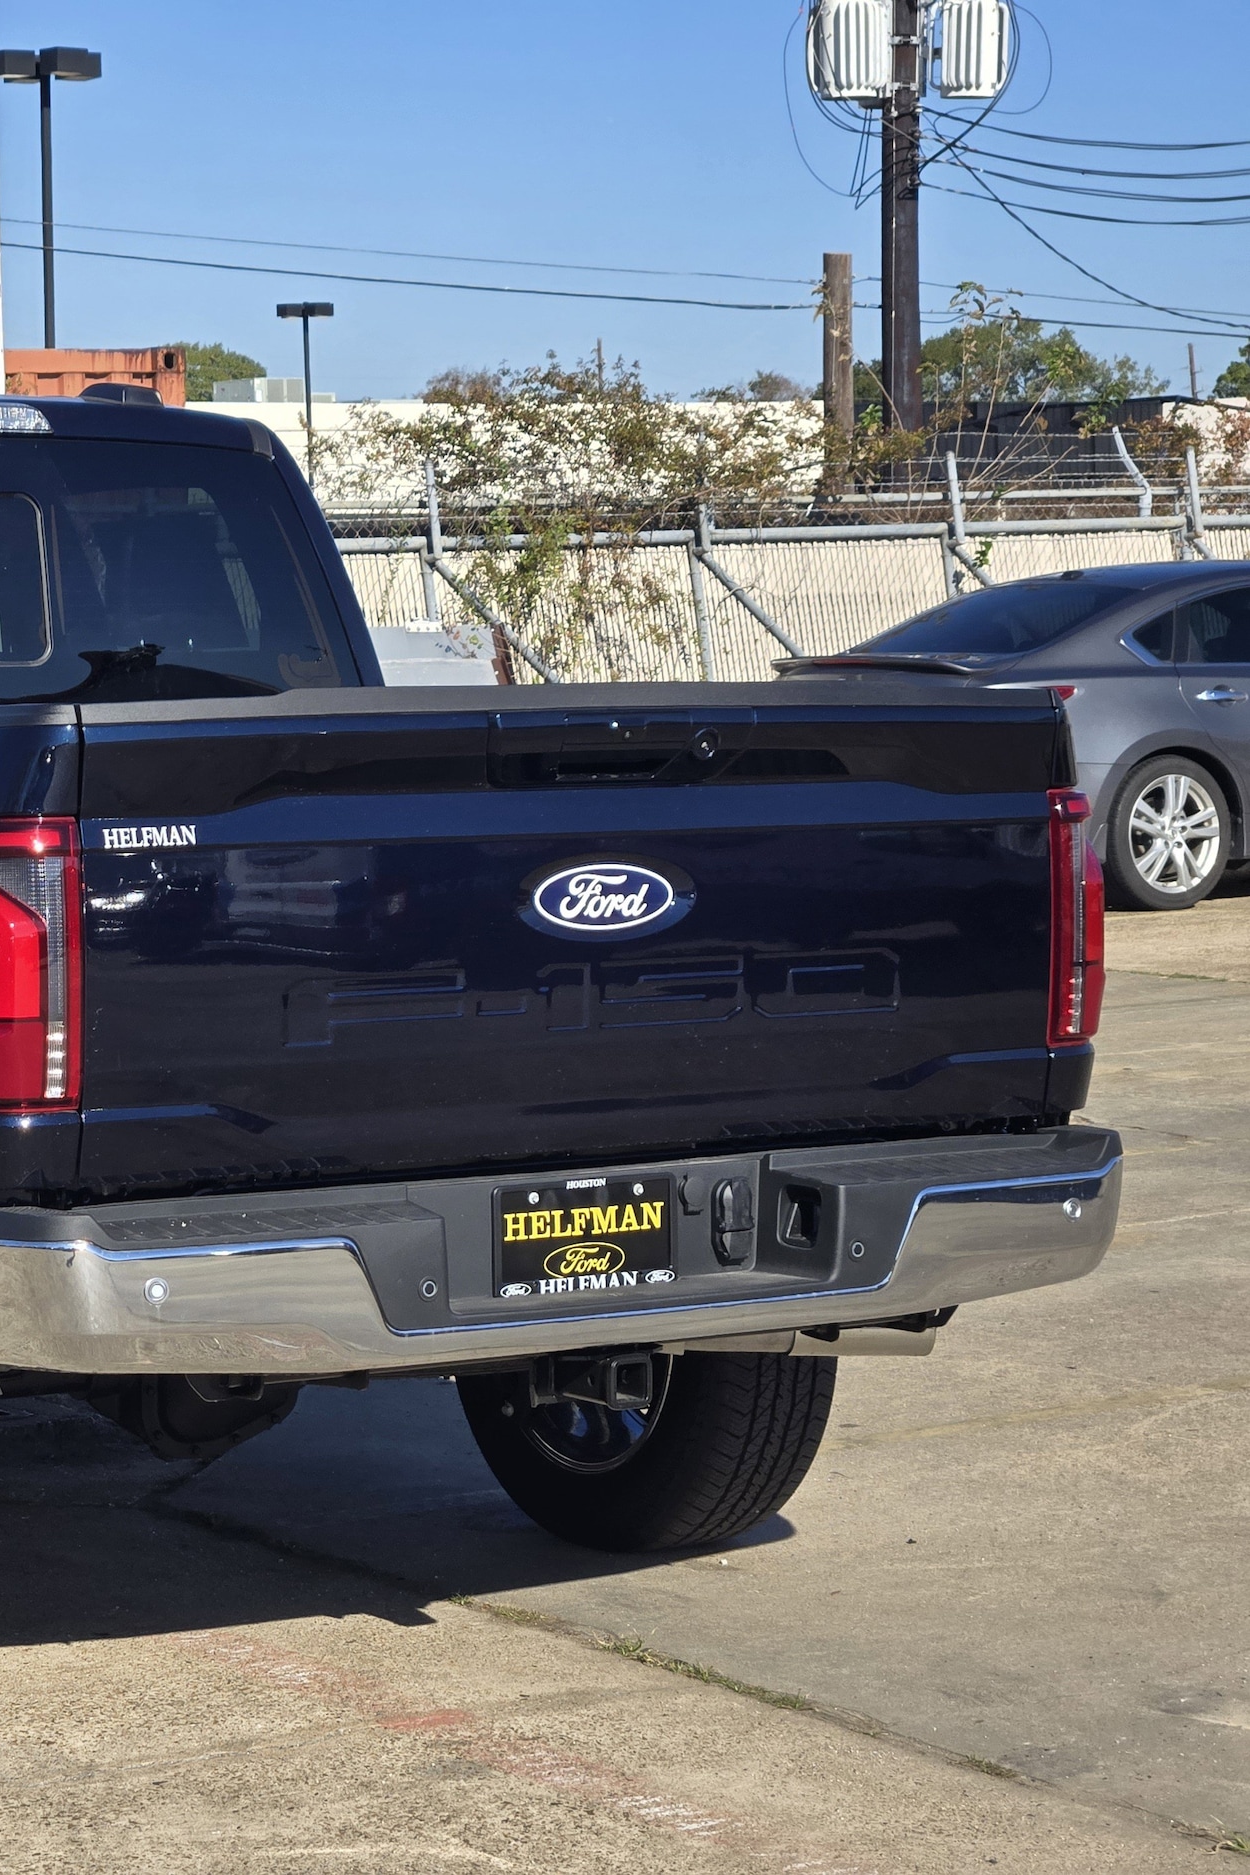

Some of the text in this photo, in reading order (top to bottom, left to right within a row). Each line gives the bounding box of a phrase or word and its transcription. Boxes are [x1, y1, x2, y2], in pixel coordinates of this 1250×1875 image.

[102, 824, 198, 849] HELFMAN
[559, 873, 650, 919] Ford
[566, 1178, 607, 1190] HOUSTON
[503, 1201, 665, 1241] HELFMAN
[559, 1246, 611, 1274] Ford
